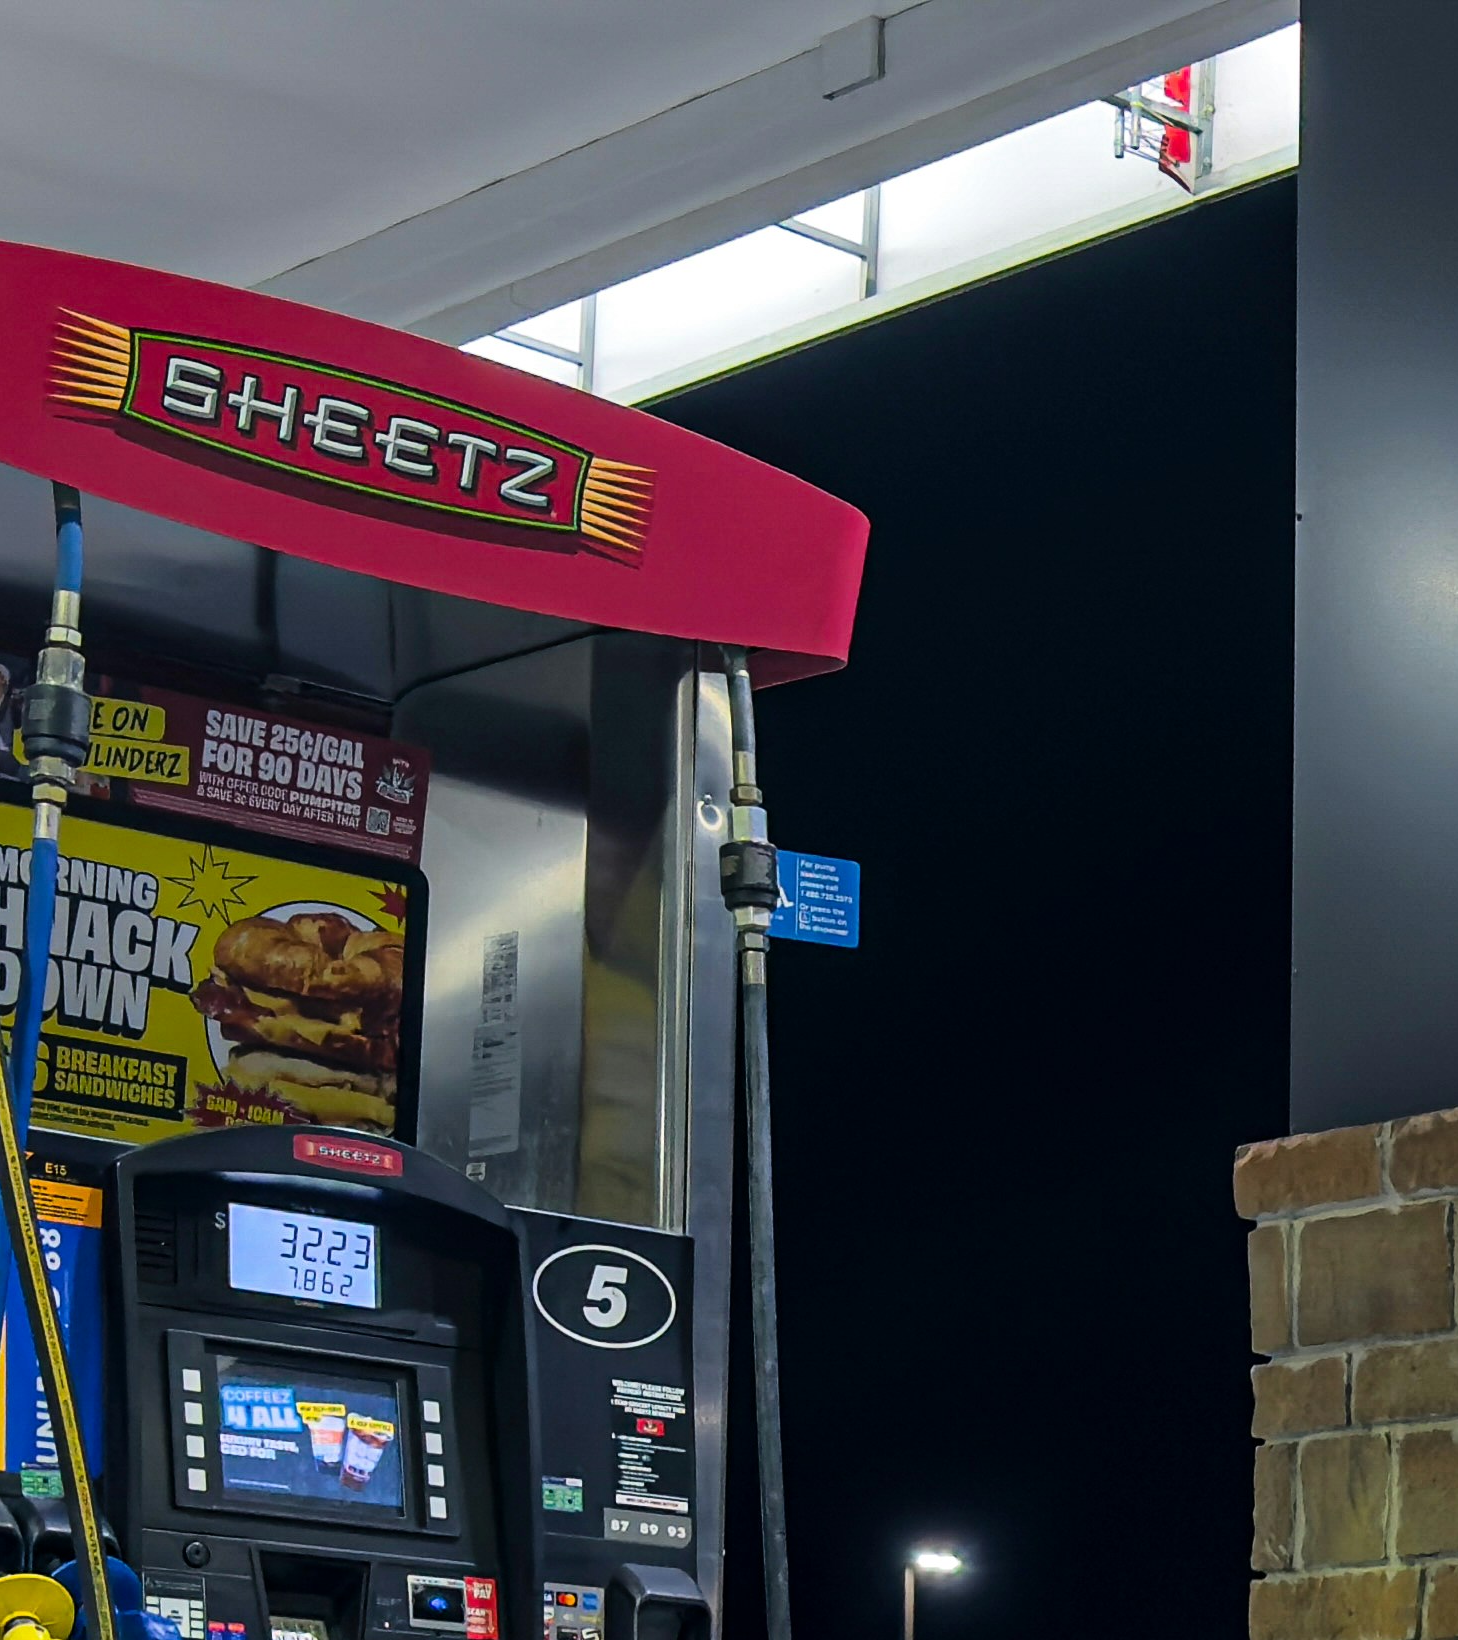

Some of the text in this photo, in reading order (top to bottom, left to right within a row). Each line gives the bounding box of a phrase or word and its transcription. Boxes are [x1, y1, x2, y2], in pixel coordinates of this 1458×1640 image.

[163, 355, 556, 510] SHEETZ
[112, 706, 149, 732] ON
[206, 709, 364, 769] SAVE 25¢/GAL
[83, 742, 182, 778] YLINDERZ
[202, 739, 253, 776] FOR
[258, 752, 292, 785] 90
[297, 761, 362, 801] DAYS
[207, 787, 232, 802] SAVE
[249, 795, 279, 811] EVERY
[282, 803, 300, 816] DAY
[303, 808, 333, 824] AFTER
[337, 814, 361, 829] THAT
[56, 1046, 178, 1087] BREAKFAST
[55, 1070, 175, 1109] SANDWICHES
[45, 1162, 67, 1176] E15
[319, 1145, 381, 1164] SHEETZ
[280, 1223, 371, 1269] 32.23
[289, 1266, 352, 1297] 7.862
[582, 1264, 628, 1328] 5
[252, 1406, 298, 1428] ALL
[610, 1519, 686, 1539] 87 89 93
